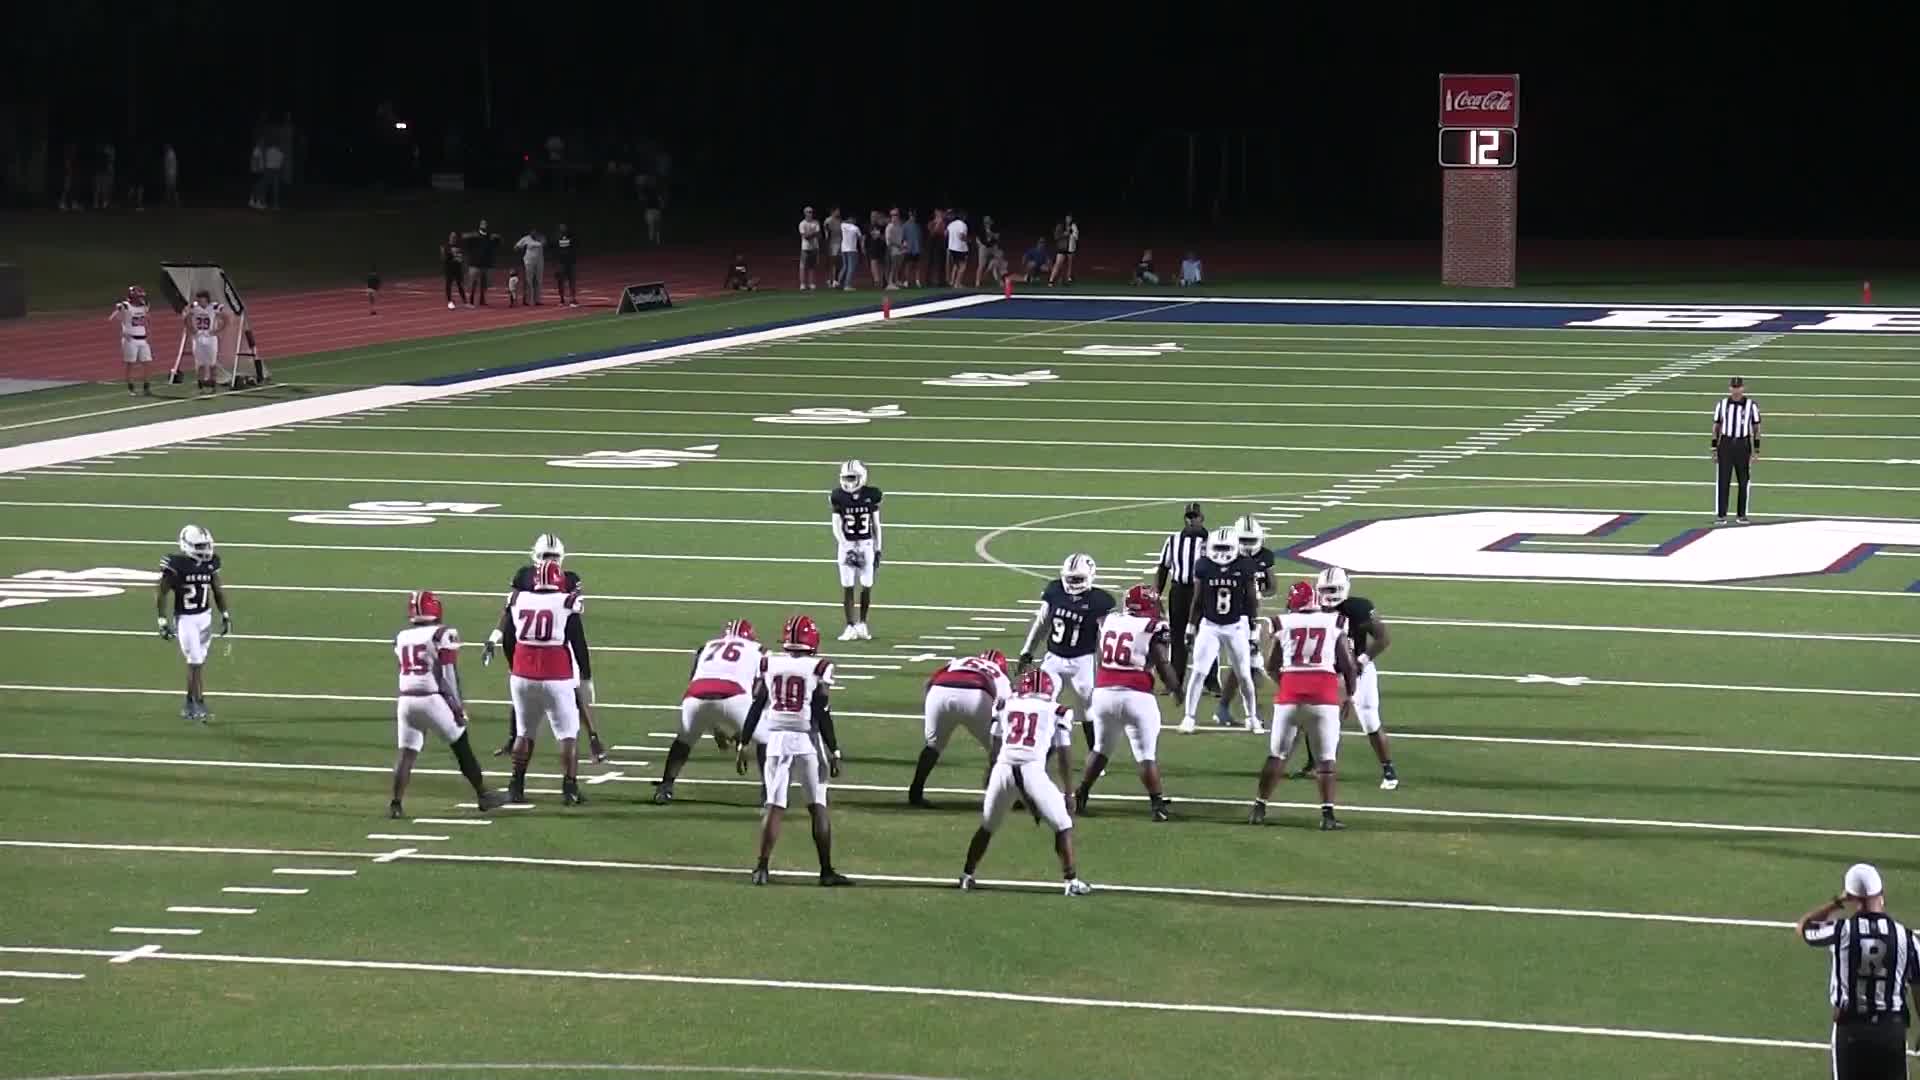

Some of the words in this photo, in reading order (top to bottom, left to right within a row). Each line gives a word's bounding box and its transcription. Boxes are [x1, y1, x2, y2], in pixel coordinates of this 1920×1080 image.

[1470, 130, 1499, 165] 12
[844, 513, 871, 534] 23
[183, 584, 209, 609] 21
[1217, 587, 1231, 614] 8
[518, 609, 553, 641] 70
[1051, 617, 1080, 646] 91
[704, 641, 745, 662] 76
[1103, 630, 1134, 666] 66
[1290, 627, 1327, 664] 77
[1006, 710, 1039, 747] 31
[1857, 938, 1889, 977] R
